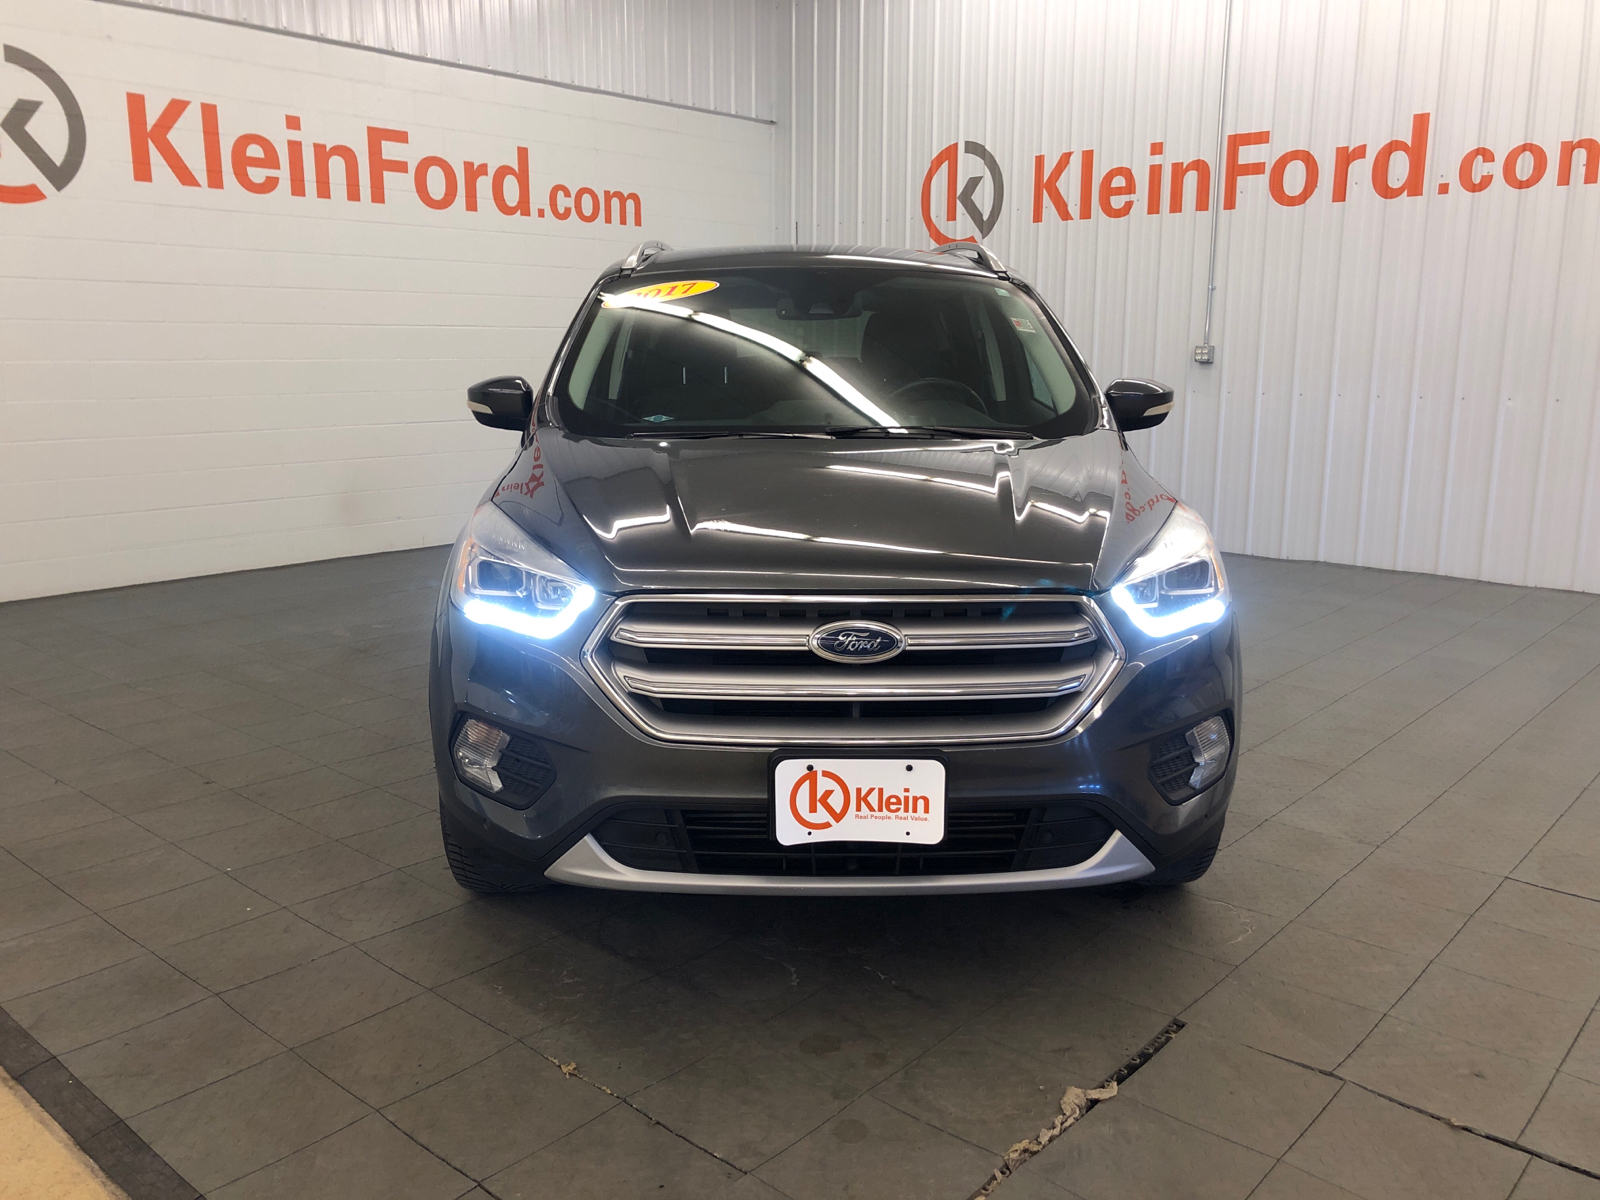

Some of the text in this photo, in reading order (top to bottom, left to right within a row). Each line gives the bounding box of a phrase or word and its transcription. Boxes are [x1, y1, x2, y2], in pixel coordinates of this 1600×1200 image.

[126, 91, 642, 227] KleinFord.com
[635, 281, 698, 300] 017
[834, 631, 881, 651] Ford
[855, 787, 930, 814] Klein
